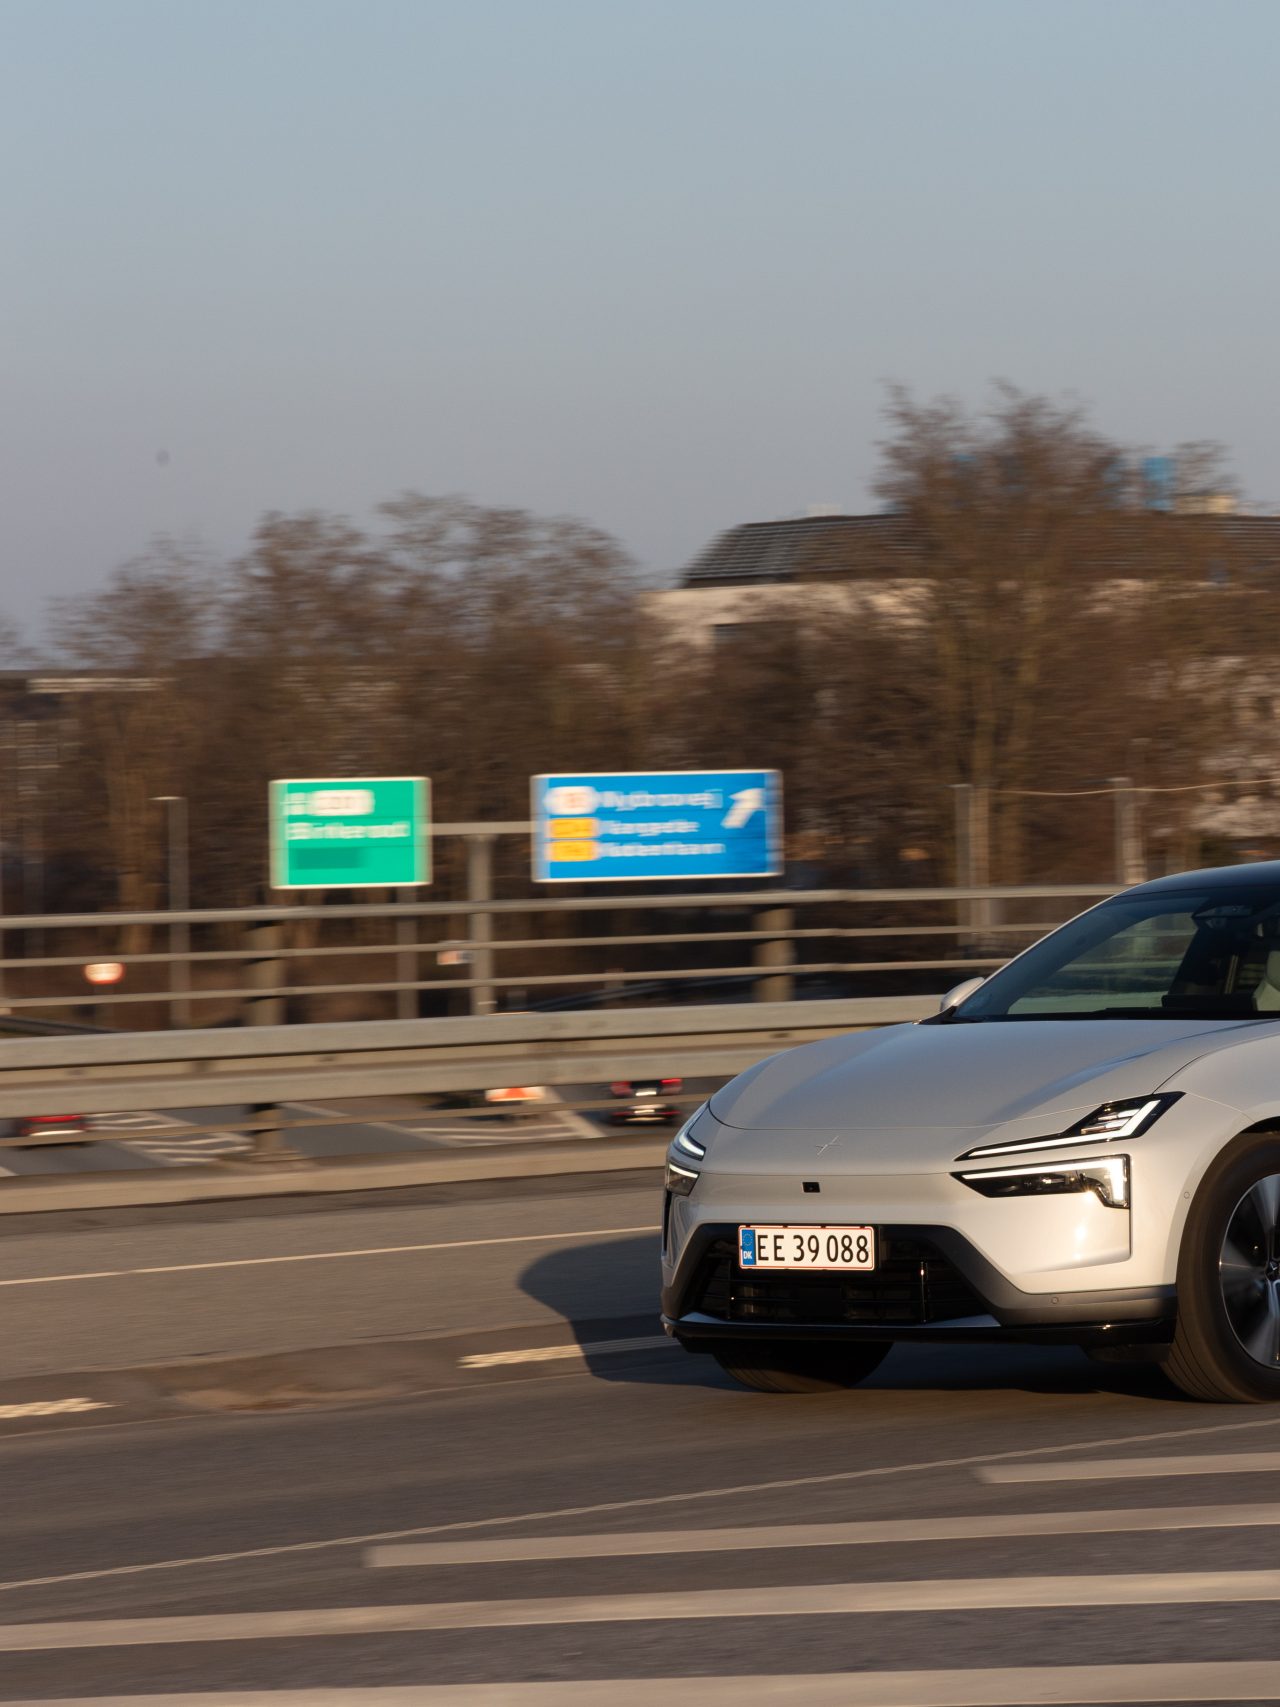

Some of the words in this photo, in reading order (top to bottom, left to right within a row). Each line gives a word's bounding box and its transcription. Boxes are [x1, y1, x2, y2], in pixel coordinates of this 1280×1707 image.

[743, 1250, 753, 1260] DK
[757, 1234, 785, 1262] EE
[793, 1234, 820, 1263] 39
[826, 1234, 869, 1263] 088
